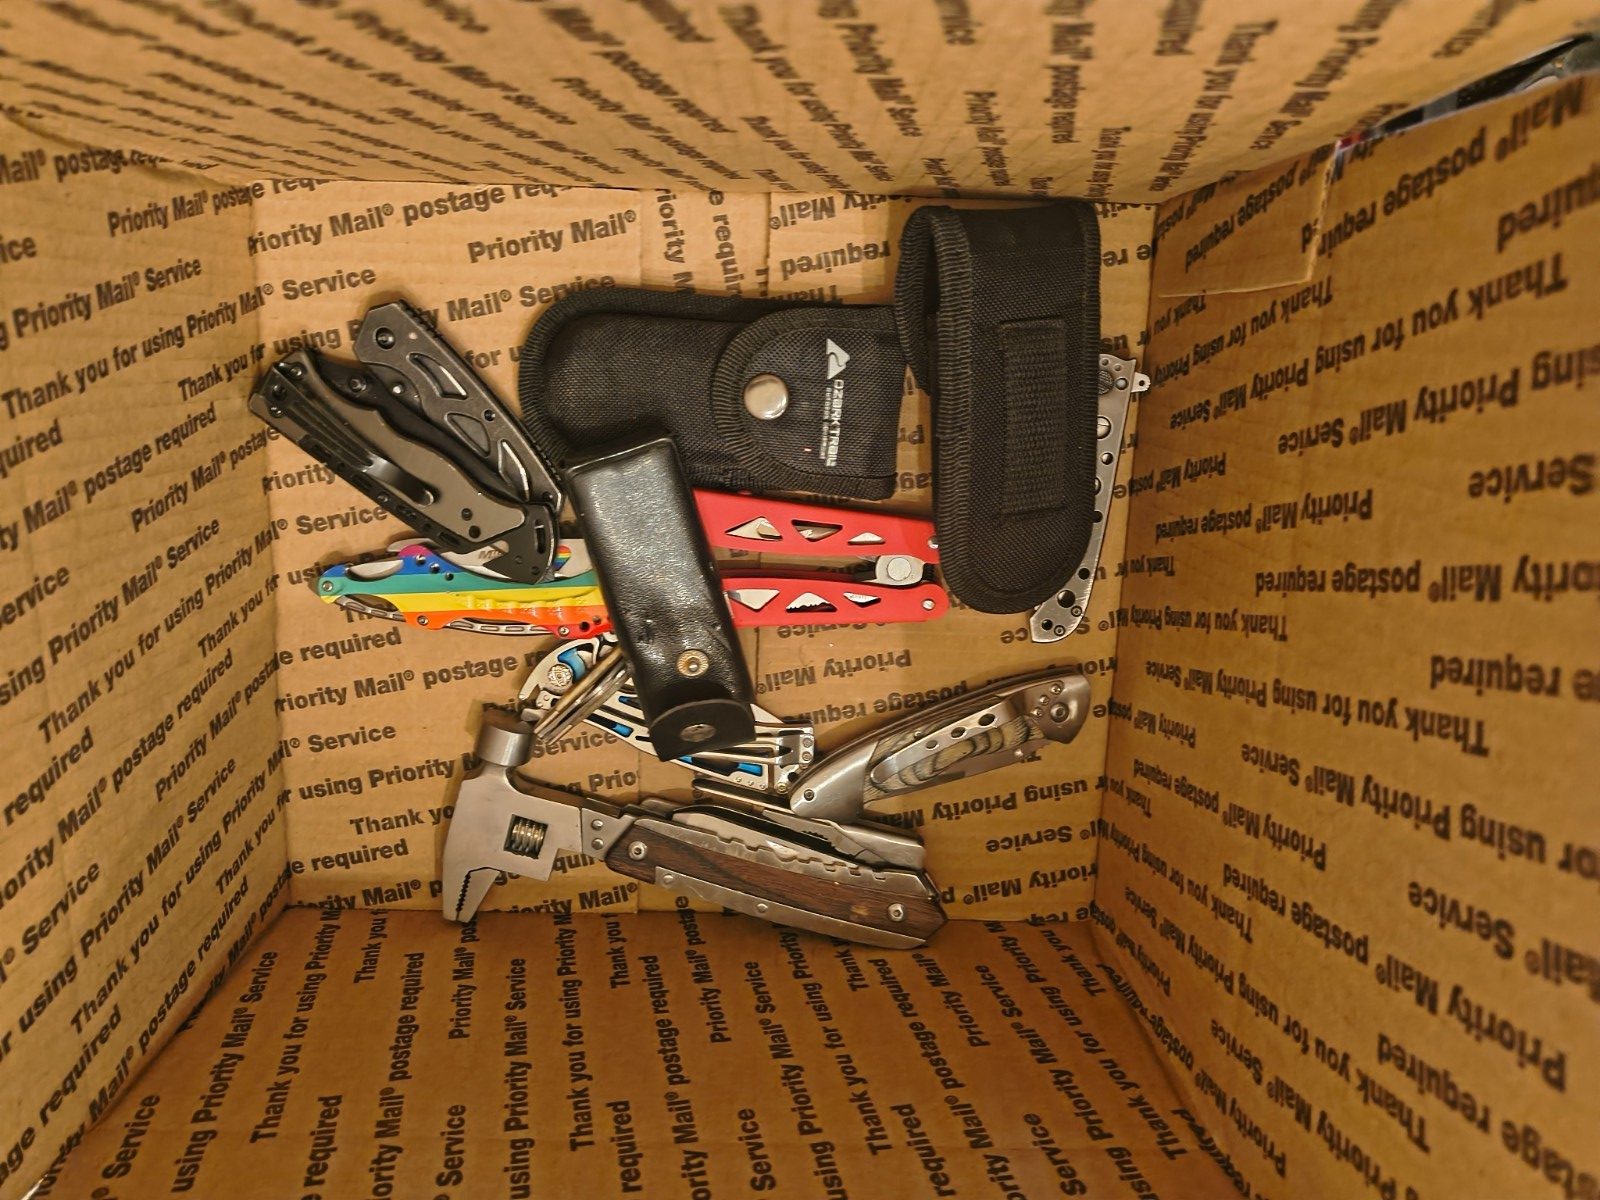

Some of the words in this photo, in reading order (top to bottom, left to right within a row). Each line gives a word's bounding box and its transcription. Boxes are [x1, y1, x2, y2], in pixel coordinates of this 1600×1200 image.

[1237, 162, 1297, 227] postage
[1383, 125, 1487, 217] postage
[248, 222, 322, 256] riority
[403, 184, 505, 226] postage
[467, 227, 564, 263] Priority
[655, 188, 686, 263] riority
[1185, 217, 1235, 273] required
[780, 240, 891, 280] required
[1173, 290, 1207, 323] Thank
[1467, 252, 1569, 321] Thank
[1153, 310, 1171, 336] you
[1371, 317, 1405, 351] for
[1411, 287, 1460, 337] you
[1, 370, 72, 419] Thank
[74, 358, 109, 393] you
[112, 343, 137, 371] for
[142, 325, 184, 359] using
[186, 303, 237, 338] Priority
[283, 267, 376, 300] Service
[178, 365, 222, 401] Thank
[225, 353, 248, 376] you
[273, 326, 341, 355] using
[464, 347, 502, 369] for
[1315, 334, 1366, 375] using
[830, 379, 845, 425] OZARK
[1251, 357, 1309, 400] Priority
[1170, 398, 1211, 431] Service
[83, 443, 153, 504] postage
[155, 401, 217, 455] required
[826, 427, 841, 467] TRAIL
[1467, 453, 1597, 504] Service
[1255, 568, 1326, 599] required
[1331, 559, 1422, 599] postage
[38, 679, 103, 744] Thank
[103, 648, 136, 692] you
[137, 624, 161, 656] for
[164, 588, 204, 632] using
[204, 544, 253, 596] Priority
[296, 504, 388, 535] Service
[275, 686, 347, 713] riority
[422, 654, 518, 689] postage
[823, 649, 913, 678] Priority
[1145, 660, 1182, 688] Service
[1215, 668, 1268, 708] Priority
[1429, 653, 1561, 697] required
[155, 731, 208, 802] Priority
[299, 626, 402, 662] required
[874, 680, 968, 714] postage
[1272, 677, 1318, 715] using
[1322, 693, 1351, 726] for
[1357, 697, 1399, 730] you
[1404, 705, 1490, 758] Thank
[932, 795, 1018, 821] Priority
[1023, 778, 1088, 803] using
[215, 838, 255, 894] Thank
[255, 808, 276, 846] you
[299, 776, 363, 800] using
[367, 757, 456, 788] Priority
[349, 808, 425, 836] Thank
[428, 805, 455, 826] yo
[986, 825, 1073, 853] Service
[18, 954, 78, 1036] using
[79, 869, 144, 959] Priority
[187, 757, 236, 823] Service
[70, 955, 130, 1036] Thank
[130, 914, 160, 965] you
[162, 877, 183, 918] for
[185, 830, 222, 885] using
[221, 770, 267, 835] Priority
[308, 725, 397, 753] Service
[1029, 862, 1098, 890] riority
[1222, 862, 1287, 918] required
[21, 862, 100, 955] Service
[605, 920, 627, 944] you
[1291, 901, 1370, 966] postage
[138, 959, 196, 1056] postage
[197, 876, 249, 962] required
[353, 941, 382, 984] Thank
[369, 915, 388, 942] you
[554, 928, 577, 977] Priority
[606, 944, 631, 989] Thank
[779, 930, 814, 980] Priority
[834, 948, 870, 992] Thank
[998, 935, 1047, 984] Priority
[1188, 934, 1235, 996] Priority
[239, 951, 279, 1003] Service
[558, 979, 583, 1020] using
[744, 961, 777, 1014] Service
[803, 982, 833, 1022] using
[1238, 972, 1280, 1026] using
[1040, 986, 1083, 1027] using
[562, 1023, 584, 1048] for
[822, 1026, 846, 1050] for
[1074, 1029, 1105, 1055] for
[1283, 1014, 1310, 1056] for
[1314, 1037, 1351, 1083] you
[1447, 983, 1567, 1093] Priority
[38, 1003, 122, 1127] required
[191, 1052, 245, 1124] Priority
[569, 1051, 593, 1082] you
[835, 1054, 868, 1087] you
[1098, 1058, 1140, 1091] you
[1377, 1032, 1491, 1134] required
[566, 1086, 596, 1152] Thank
[780, 1063, 824, 1136] Priority
[849, 1089, 893, 1156] Thank
[1355, 1068, 1431, 1154] Thank
[102, 1094, 161, 1180] Service
[303, 1094, 343, 1188] required
[435, 1104, 466, 1187] Service
[606, 1100, 643, 1194] required
[737, 1108, 777, 1192] Service
[890, 1103, 956, 1198] required
[1127, 1094, 1188, 1161] Thank
[170, 1128, 218, 1193] using
[1023, 1112, 1087, 1196] Service
